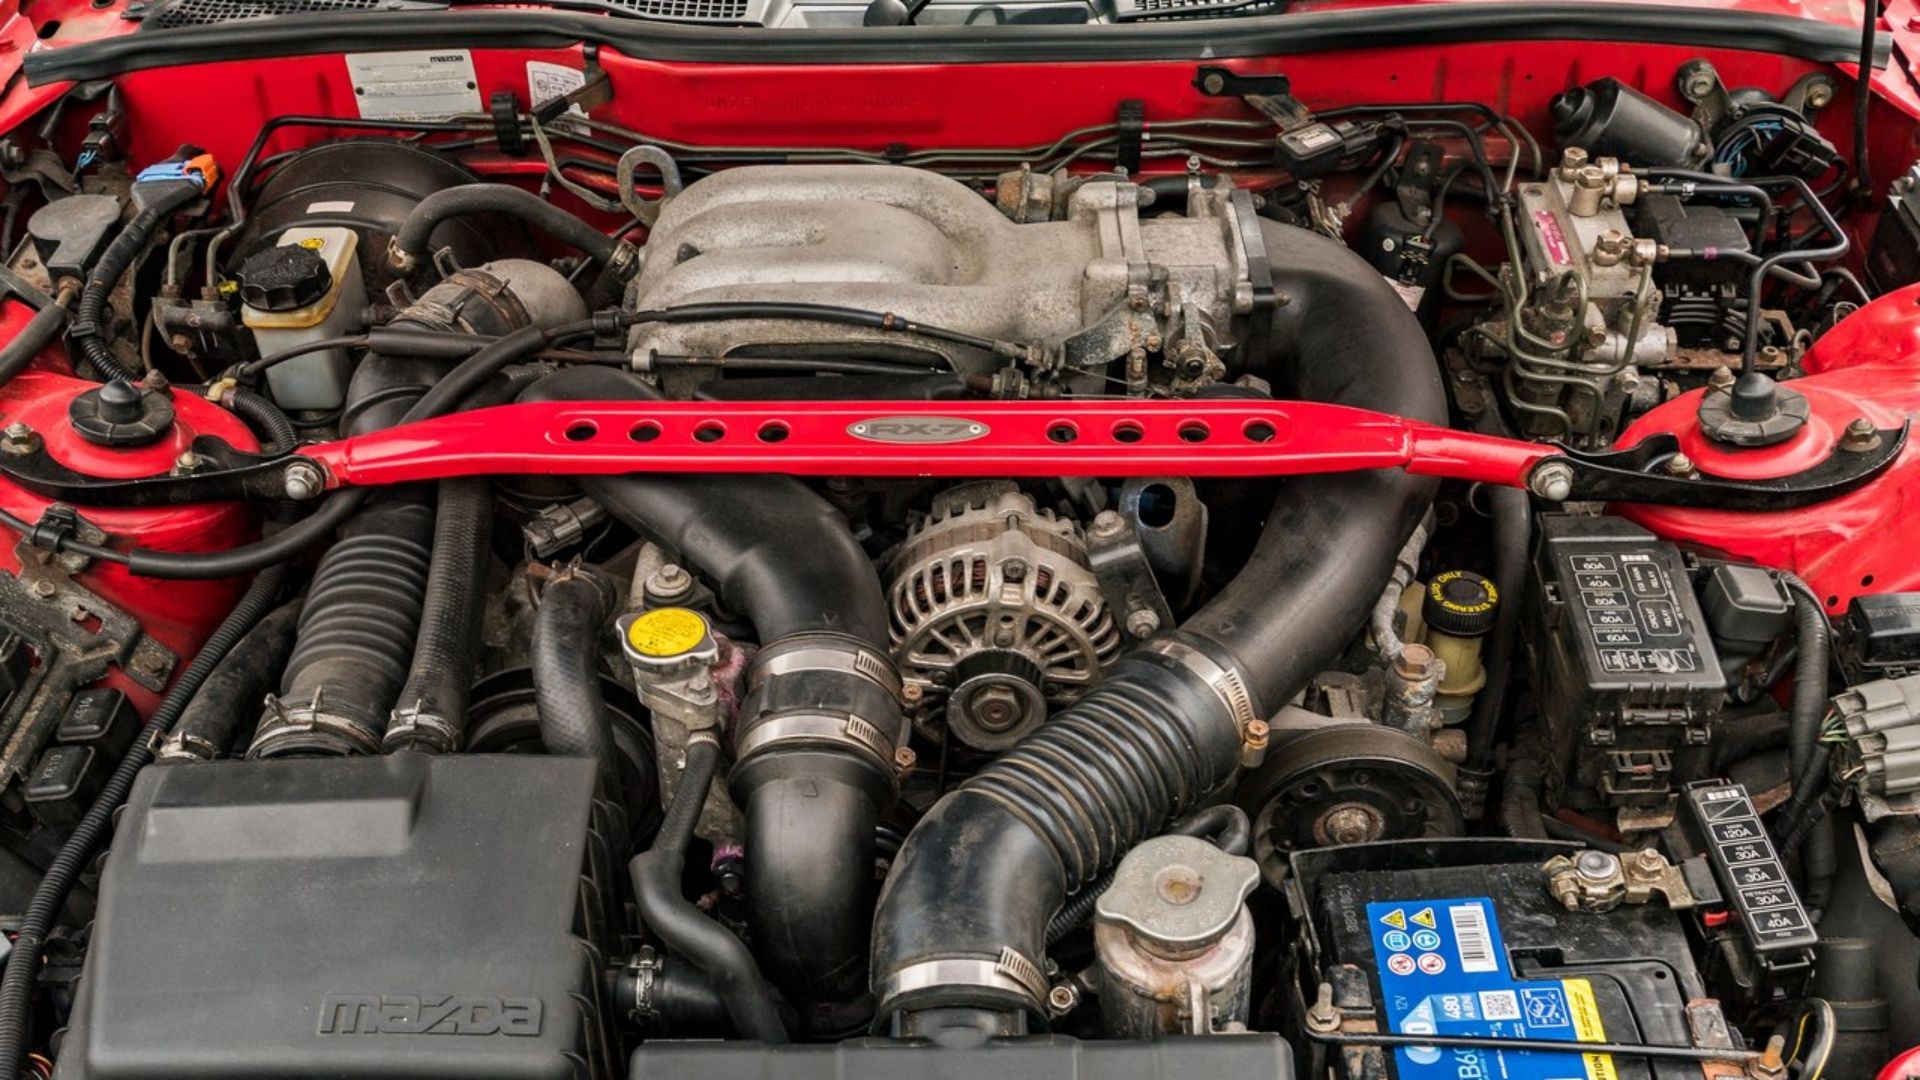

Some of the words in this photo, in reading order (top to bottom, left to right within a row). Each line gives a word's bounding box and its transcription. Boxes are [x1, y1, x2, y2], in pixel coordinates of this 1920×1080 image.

[870, 423, 970, 436] RX-7
[1583, 562, 1606, 570] 60A
[1437, 570, 1462, 583] ONLY
[1648, 570, 1659, 589] RELAY
[1589, 580, 1612, 588] 40A
[1480, 579, 1498, 603] POWER
[1442, 601, 1491, 613] STEERING
[1595, 598, 1618, 606] 60A
[1600, 615, 1624, 624] 60A
[1645, 607, 1660, 630] CIRCUIT
[1661, 609, 1673, 628] RELAY
[1606, 634, 1630, 642] 60A
[1723, 828, 1753, 839] 120A
[1735, 850, 1761, 860] 30A
[1745, 872, 1771, 882] 30A
[1755, 895, 1781, 905] 30A
[1767, 917, 1793, 928] 40A
[1394, 994, 1409, 1011] 12V
[1442, 995, 1461, 1020] 480
[317, 993, 544, 1037] mazda
